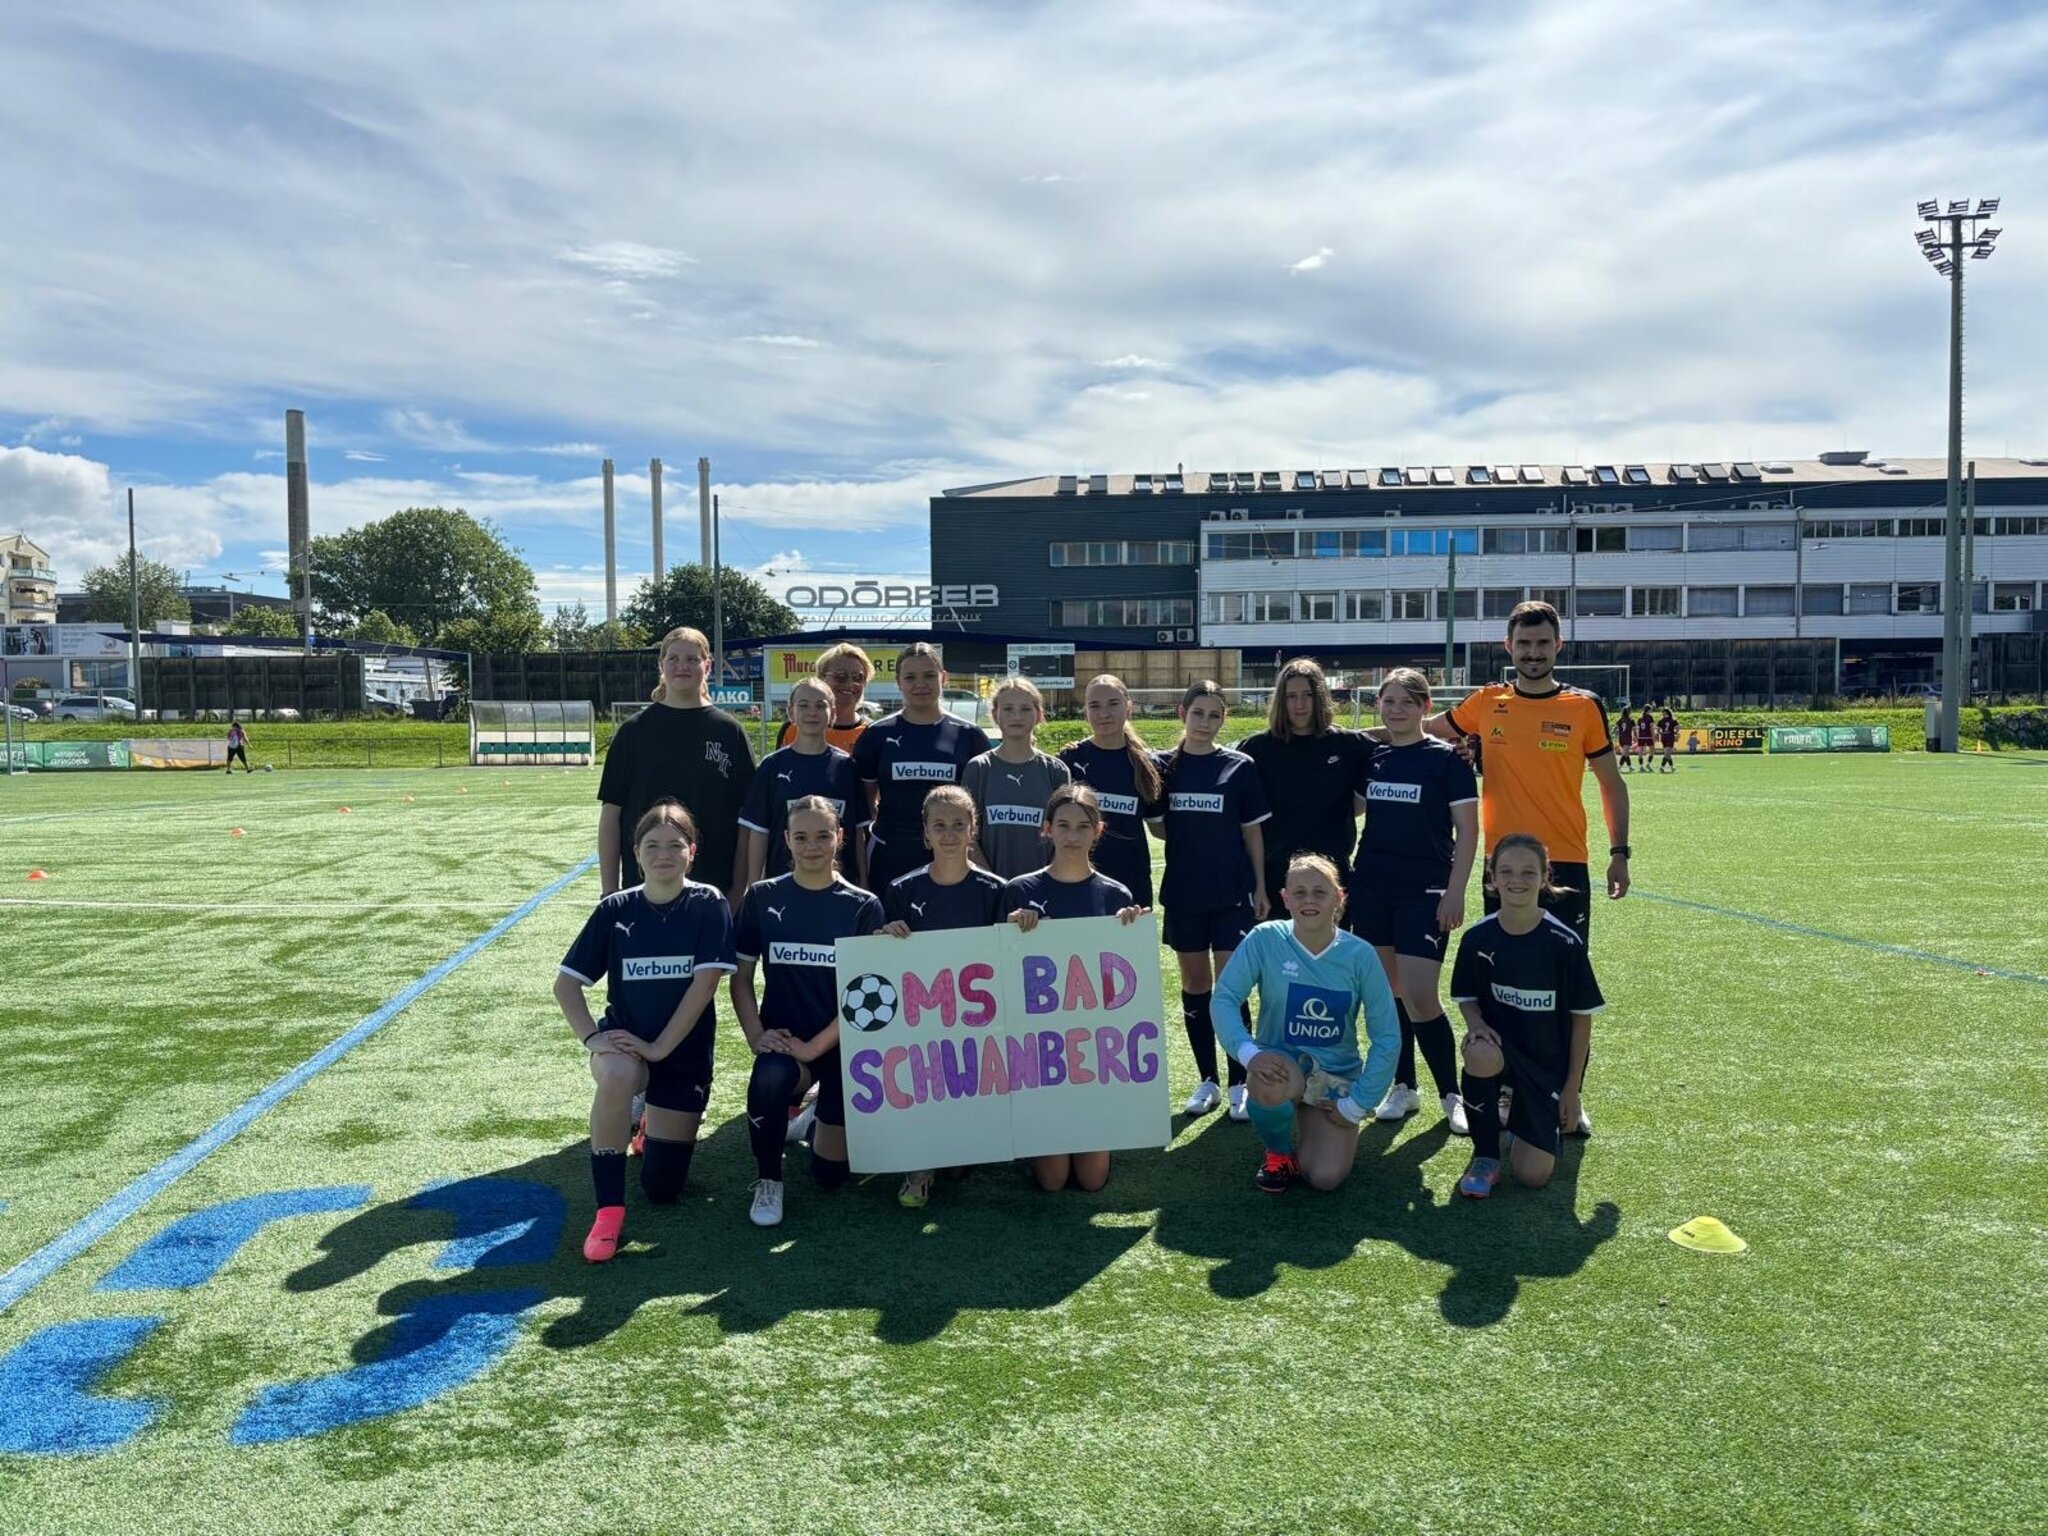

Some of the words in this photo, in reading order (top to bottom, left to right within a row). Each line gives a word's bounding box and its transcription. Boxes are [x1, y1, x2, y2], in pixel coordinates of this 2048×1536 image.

[1715, 730, 1762, 739] DIESEL
[1715, 739, 1743, 747] KINO
[895, 763, 953, 779] Verbund
[1369, 785, 1418, 800] Verbund
[1099, 796, 1135, 812] rbund
[989, 808, 1041, 824] Verbund
[626, 959, 691, 977] Verbund
[902, 963, 997, 1027] MS
[1022, 952, 1138, 1015] BAD
[1495, 987, 1553, 1008] Verbund
[1289, 1022, 1340, 1038] UNIQA
[850, 1021, 1159, 1114] SCHWANBERG
